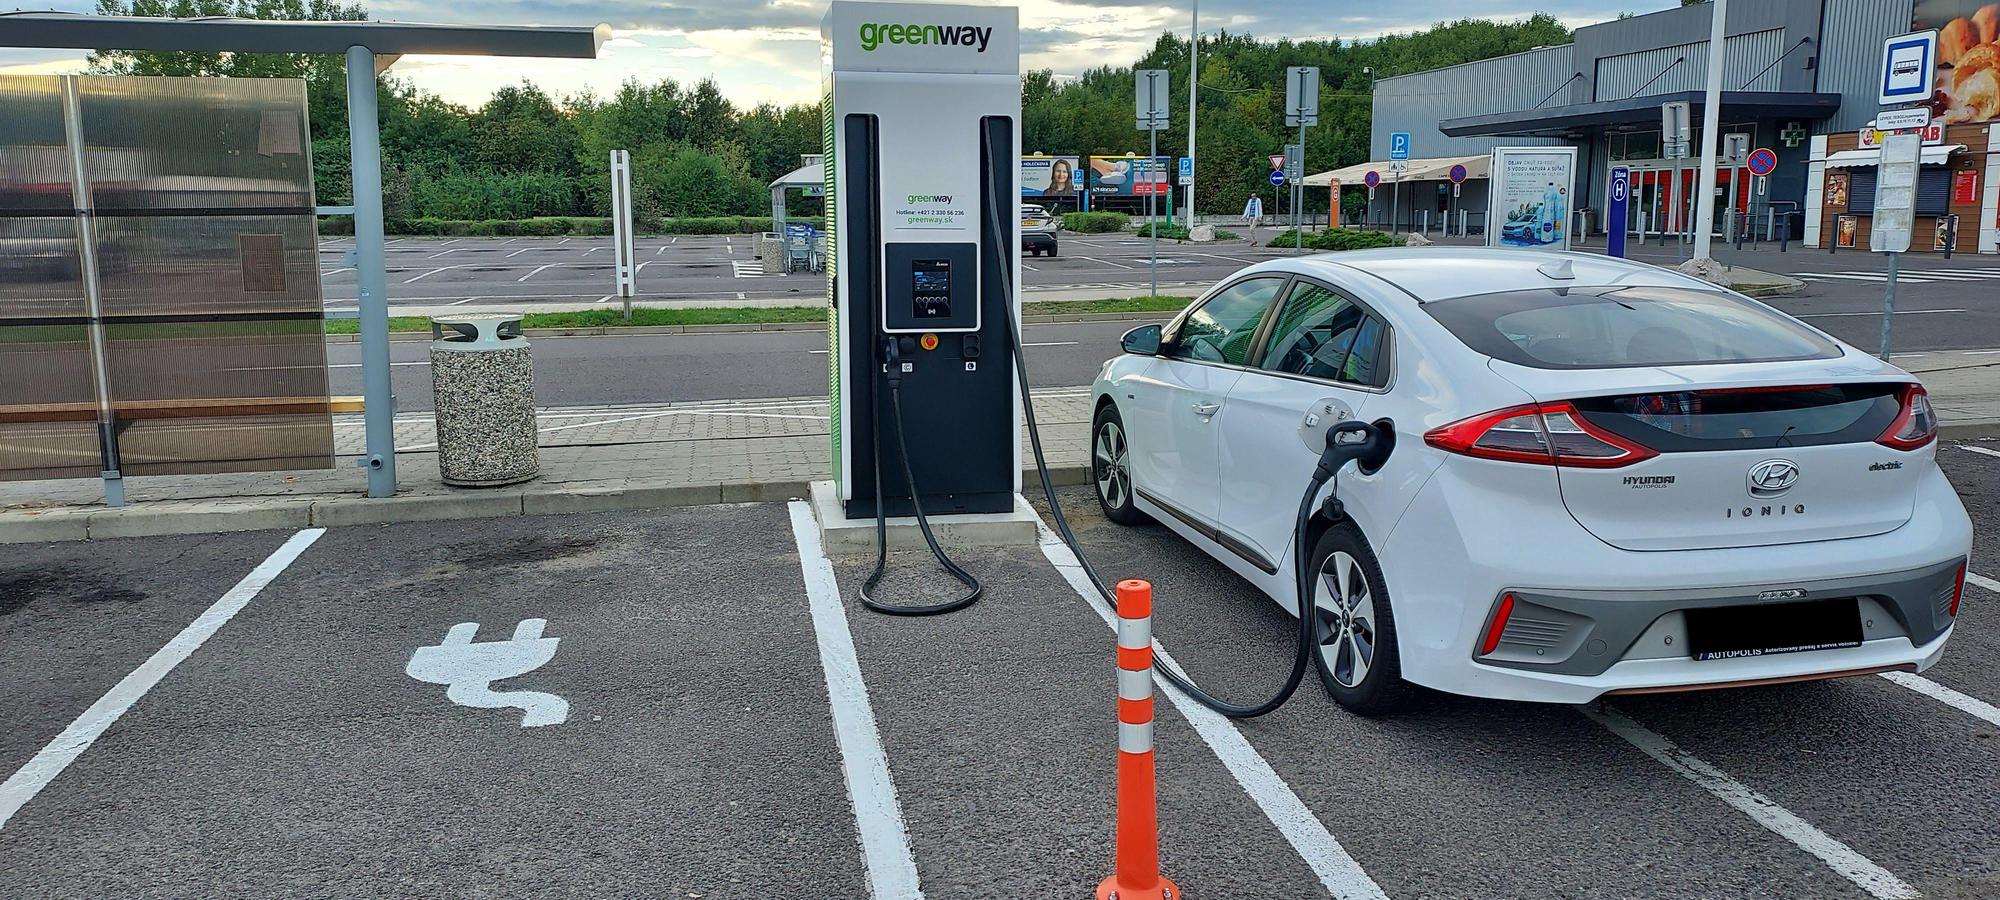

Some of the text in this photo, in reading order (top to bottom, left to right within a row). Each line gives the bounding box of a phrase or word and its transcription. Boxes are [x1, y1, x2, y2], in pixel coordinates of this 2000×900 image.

[860, 23, 992, 52] greenway
[1395, 136, 1405, 151] P
[1615, 183, 1623, 196] H
[908, 194, 953, 204] greenway
[908, 216, 953, 224] greenway.sk
[1869, 461, 1903, 471] electric
[1623, 476, 1675, 485] HYUNDAI
[1727, 504, 1805, 518] IONIQ
[1708, 649, 1762, 660] AUTOPOLIS
